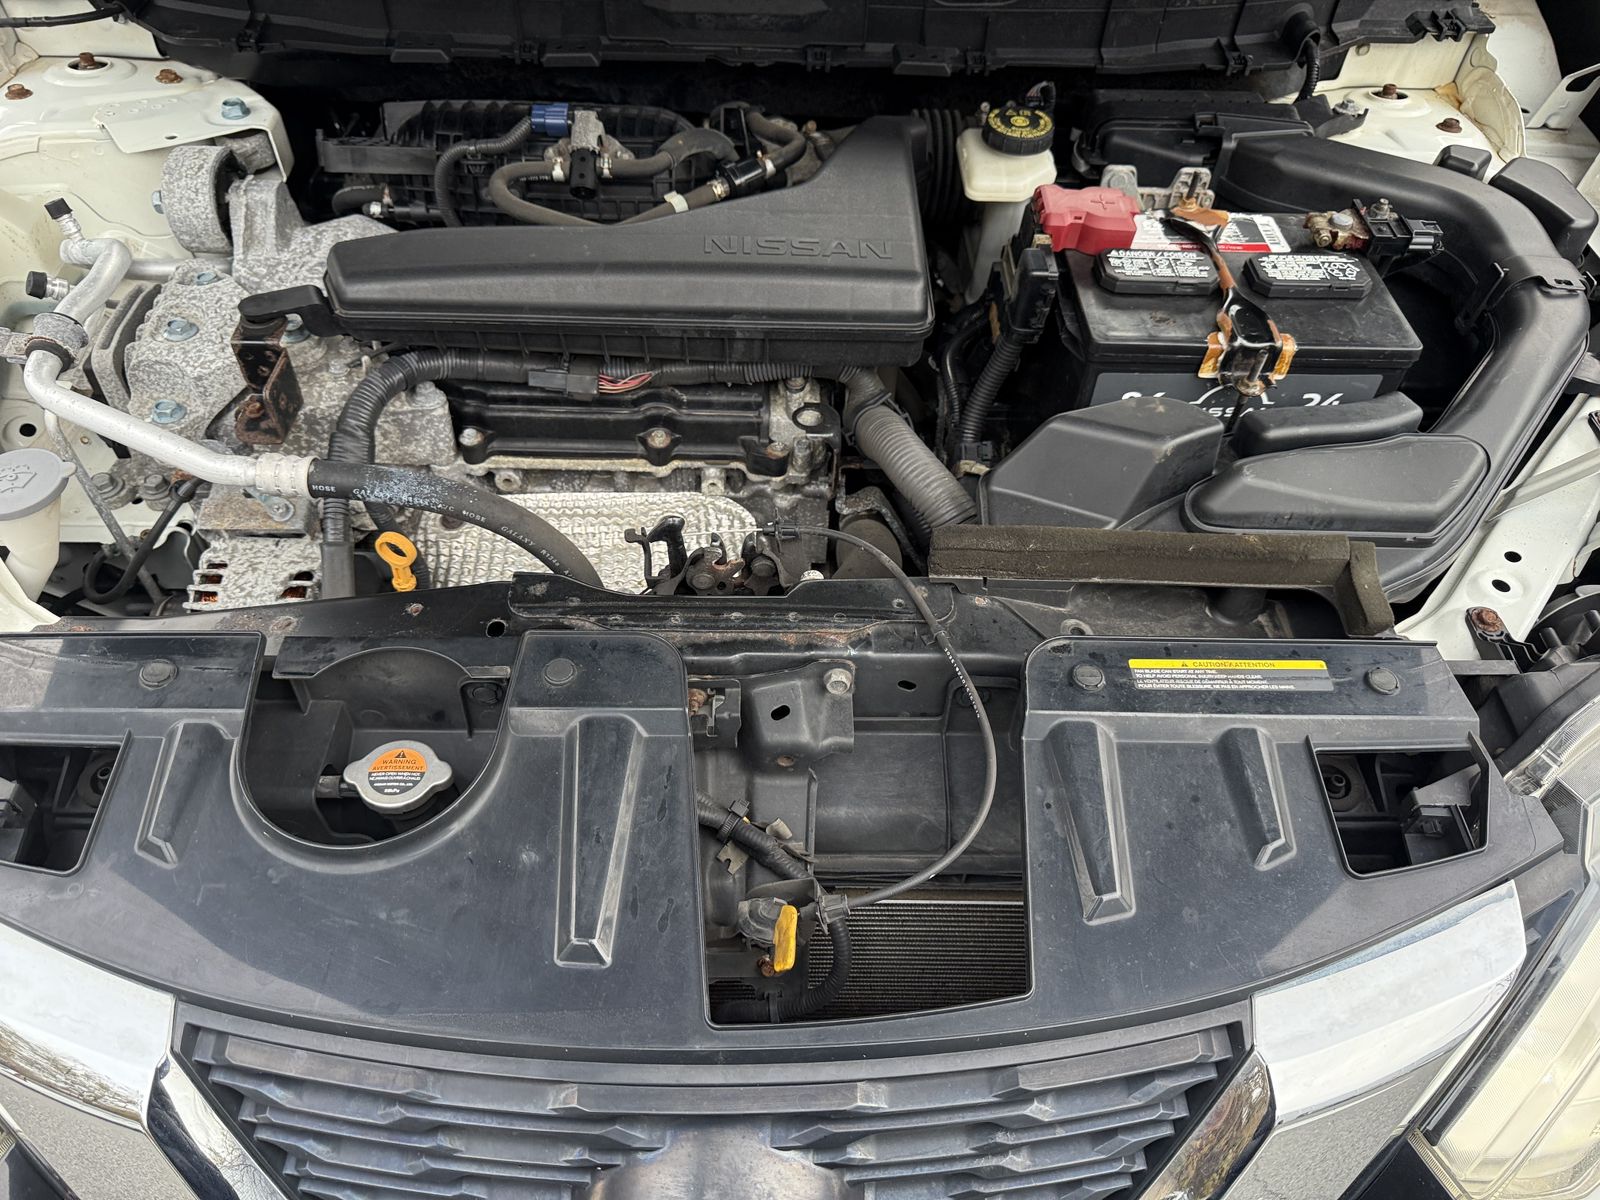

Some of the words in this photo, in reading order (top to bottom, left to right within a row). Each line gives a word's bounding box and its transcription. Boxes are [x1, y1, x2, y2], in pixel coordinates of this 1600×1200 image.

[704, 235, 892, 259] NISSAN
[1119, 250, 1156, 258] DANGER
[1163, 251, 1197, 259] POISON
[312, 484, 336, 492] HOSE
[462, 510, 487, 523] HOSE
[501, 526, 536, 547] GALAXY
